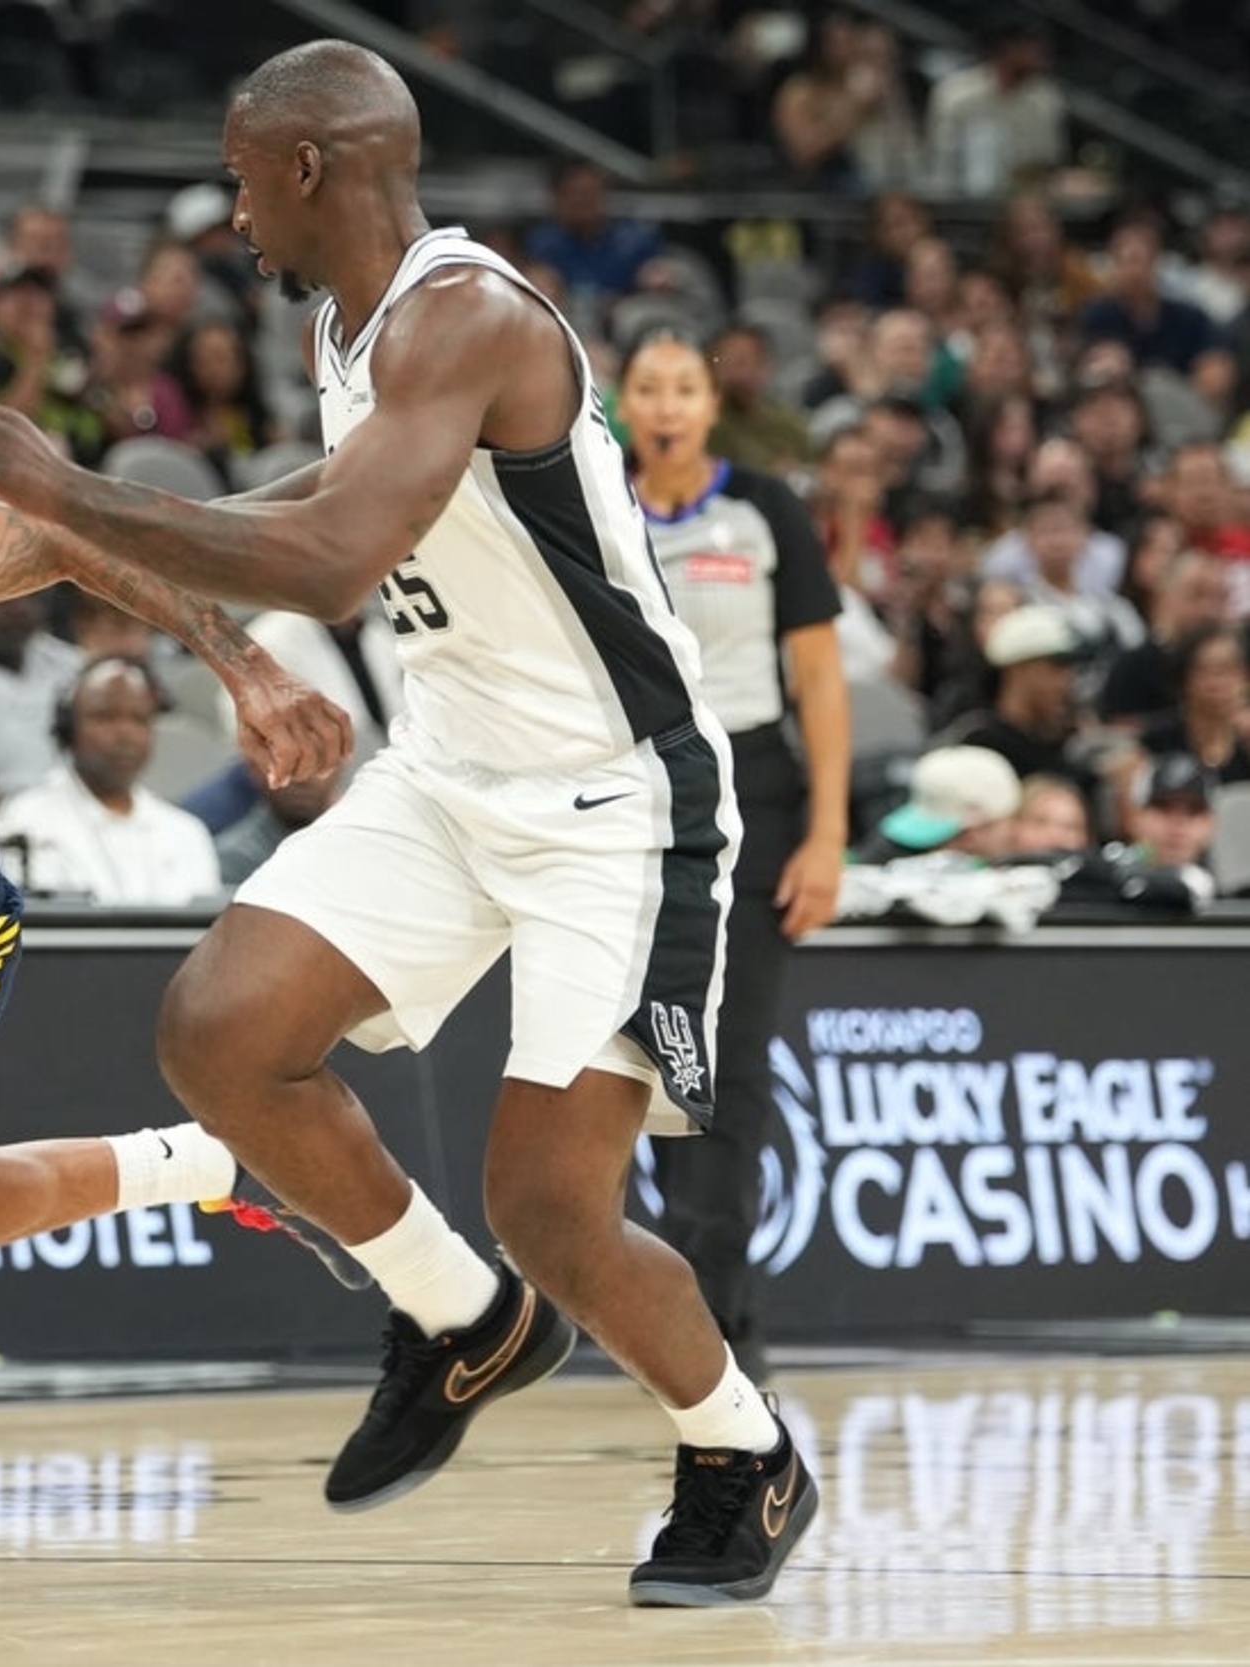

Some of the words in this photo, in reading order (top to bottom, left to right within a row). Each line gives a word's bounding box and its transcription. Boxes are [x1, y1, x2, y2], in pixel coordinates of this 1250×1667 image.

[807, 1007, 982, 1053] KICKAPOO
[816, 1056, 1008, 1146] LUCKY
[1013, 1052, 1208, 1143] EAGLE
[831, 1143, 1219, 1268] CASINO
